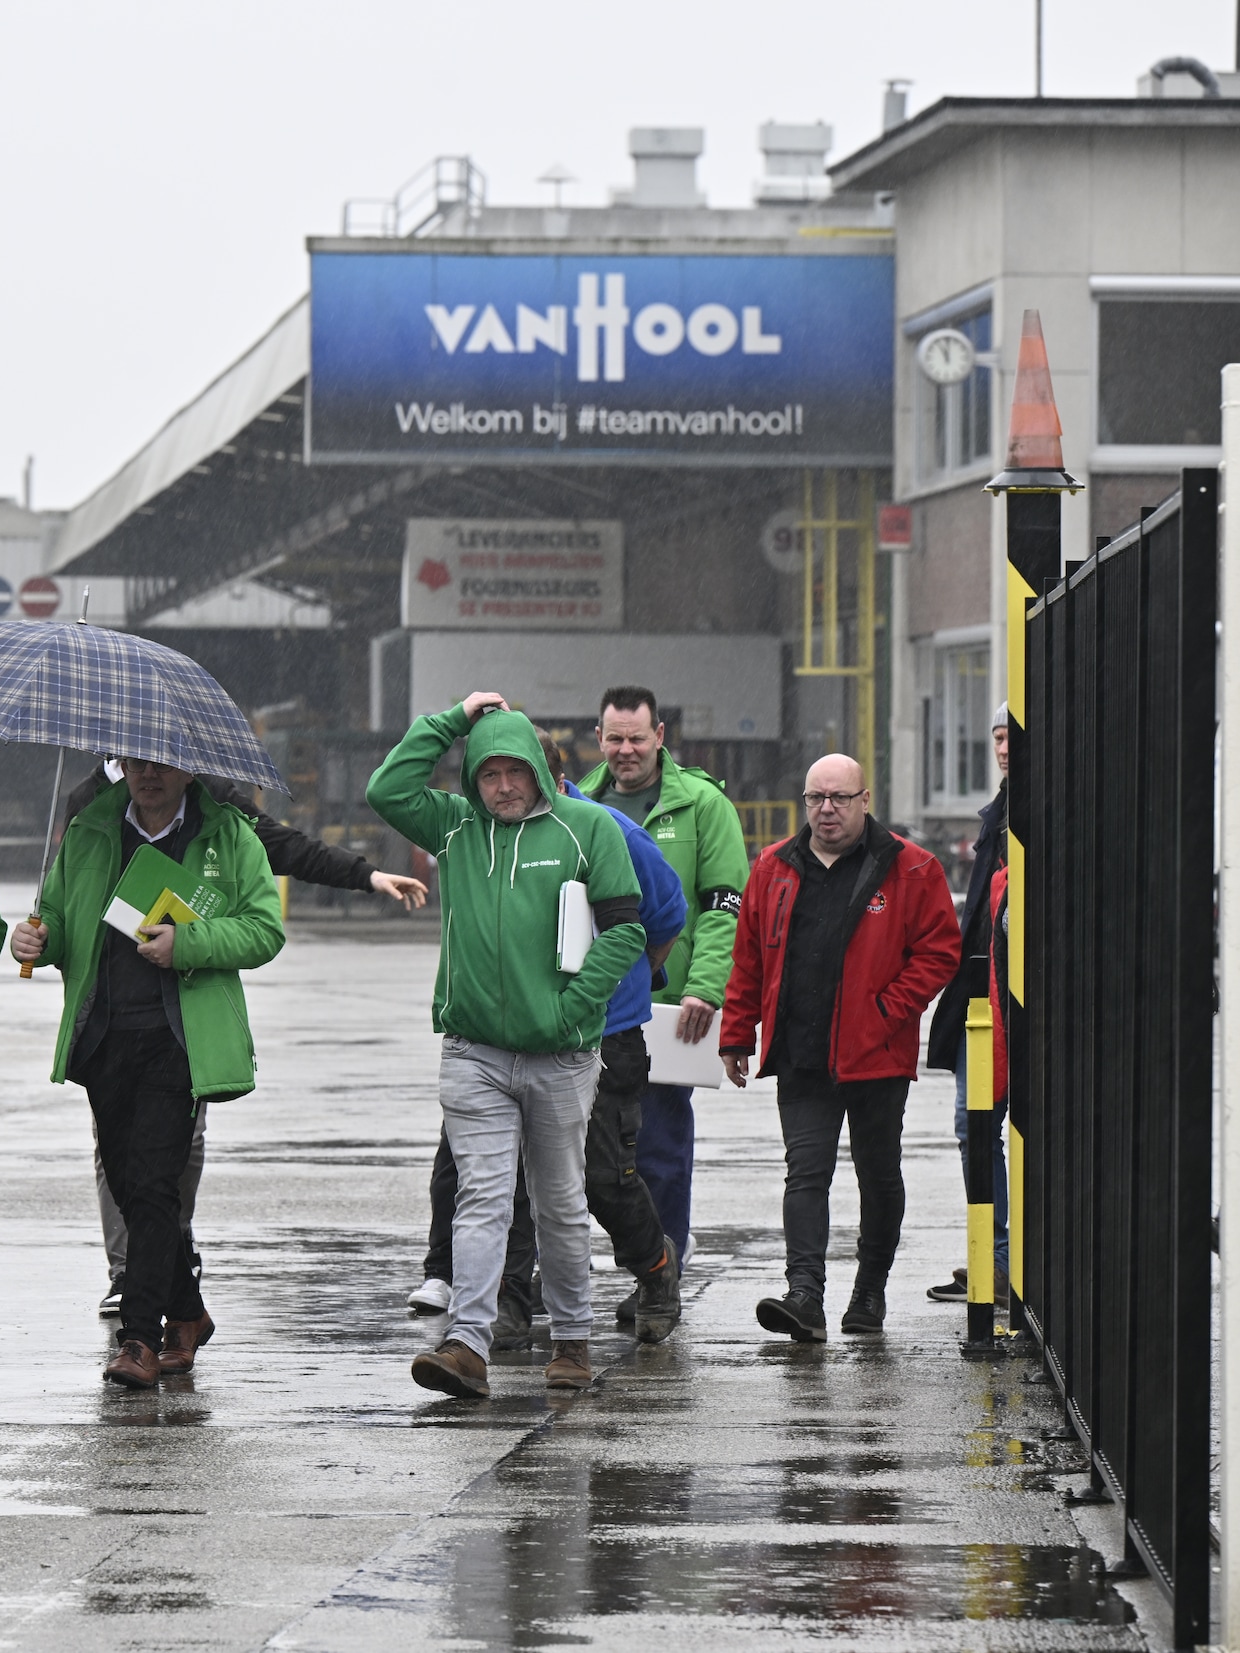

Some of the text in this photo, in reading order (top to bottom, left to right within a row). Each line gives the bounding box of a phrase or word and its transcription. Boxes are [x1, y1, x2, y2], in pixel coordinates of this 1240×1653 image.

[395, 402, 803, 441] Welkom bij #teamvanhool!
[200, 893, 216, 916] METEA
[723, 892, 742, 907] Job
